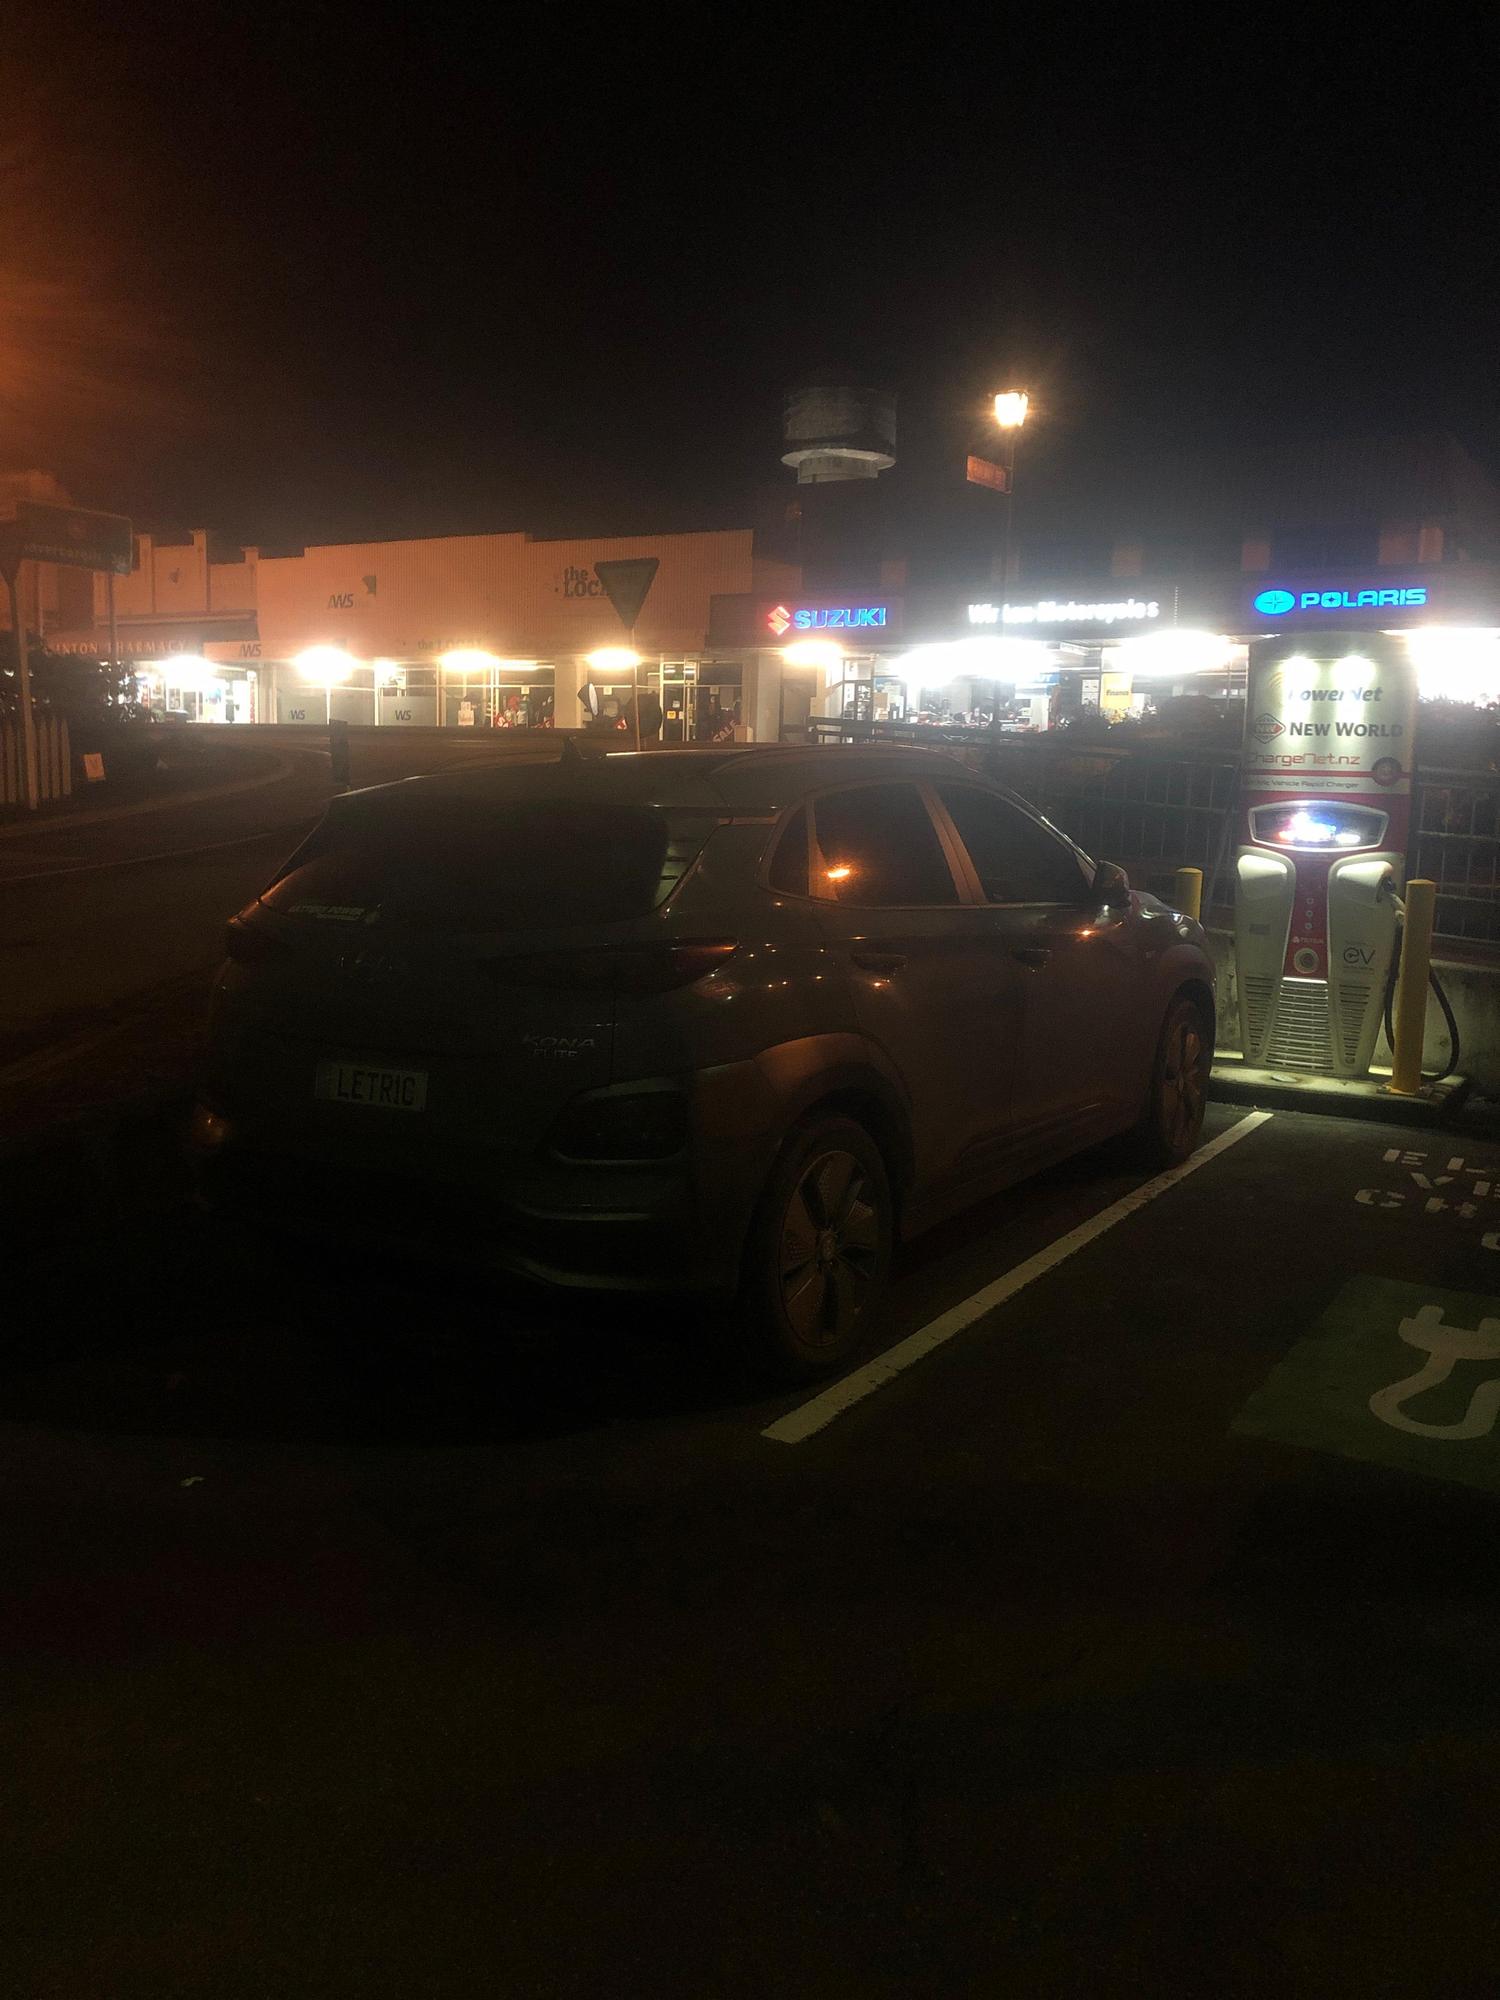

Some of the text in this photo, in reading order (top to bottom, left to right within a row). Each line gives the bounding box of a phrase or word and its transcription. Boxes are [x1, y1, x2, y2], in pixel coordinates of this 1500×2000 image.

[564, 566, 588, 580] the
[564, 580, 608, 597] LOC
[1301, 588, 1426, 609] POLARIS
[794, 607, 886, 629] SUZUKI
[1290, 721, 1331, 737] NEW
[1335, 722, 1403, 737] WORLD
[337, 1068, 416, 1105] LETRIC
